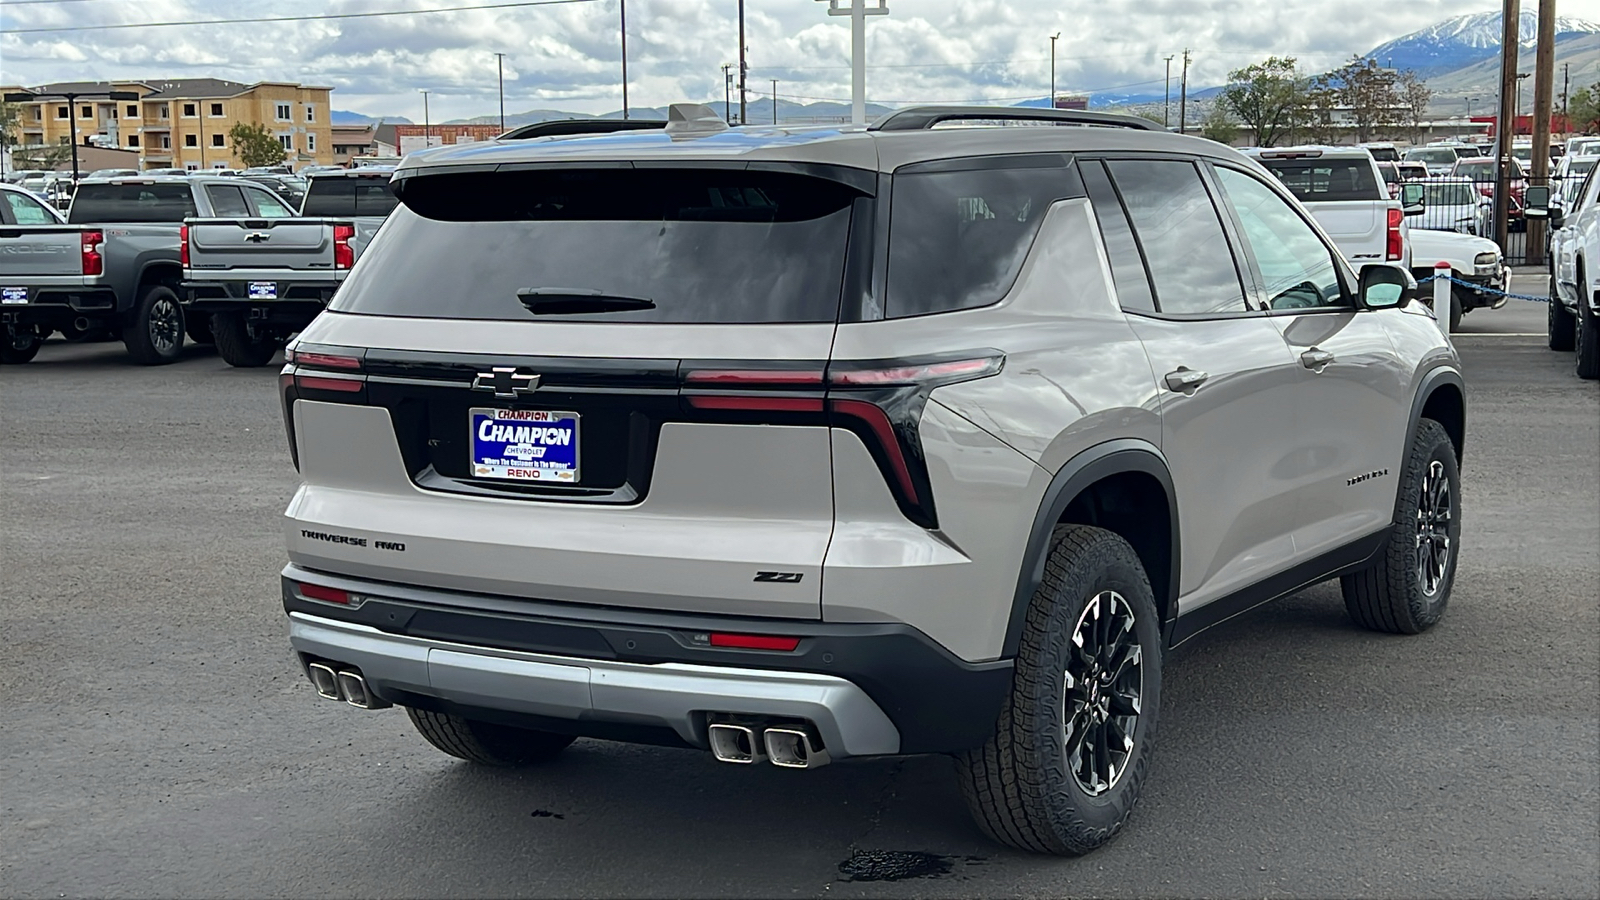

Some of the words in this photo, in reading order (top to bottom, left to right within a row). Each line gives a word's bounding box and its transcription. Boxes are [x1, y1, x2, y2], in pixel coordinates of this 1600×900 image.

[498, 410, 549, 421] CHAMPION
[478, 420, 572, 446] CHAMPION
[506, 447, 543, 456] CHEVROLET
[507, 468, 541, 478] RENO
[300, 529, 367, 547] TRAVERSE
[374, 540, 406, 552] AWD
